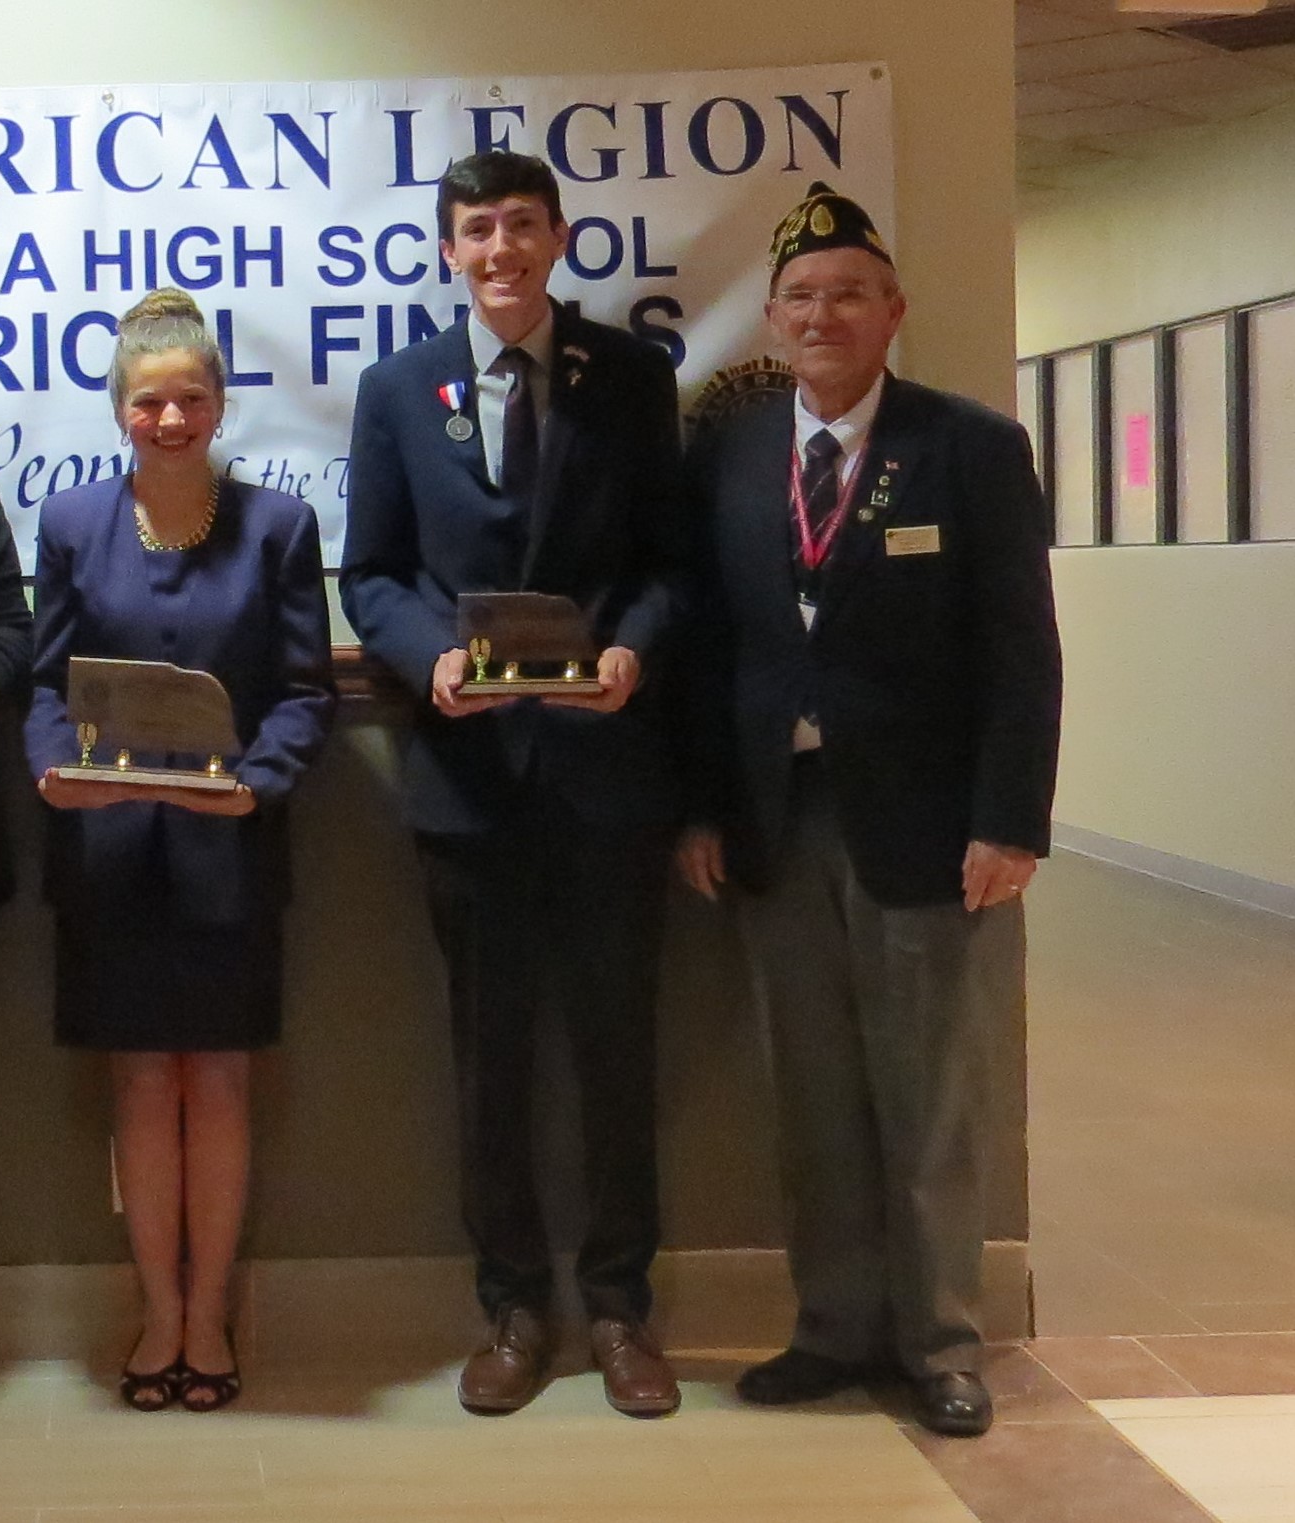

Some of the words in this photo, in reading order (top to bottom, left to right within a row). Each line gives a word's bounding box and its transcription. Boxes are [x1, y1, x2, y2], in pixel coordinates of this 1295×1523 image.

[383, 89, 850, 188] LEGION
[84, 225, 284, 292] HIGH
[316, 216, 678, 287] SCOL
[310, 295, 686, 386] FIS
[259, 458, 314, 499] the
